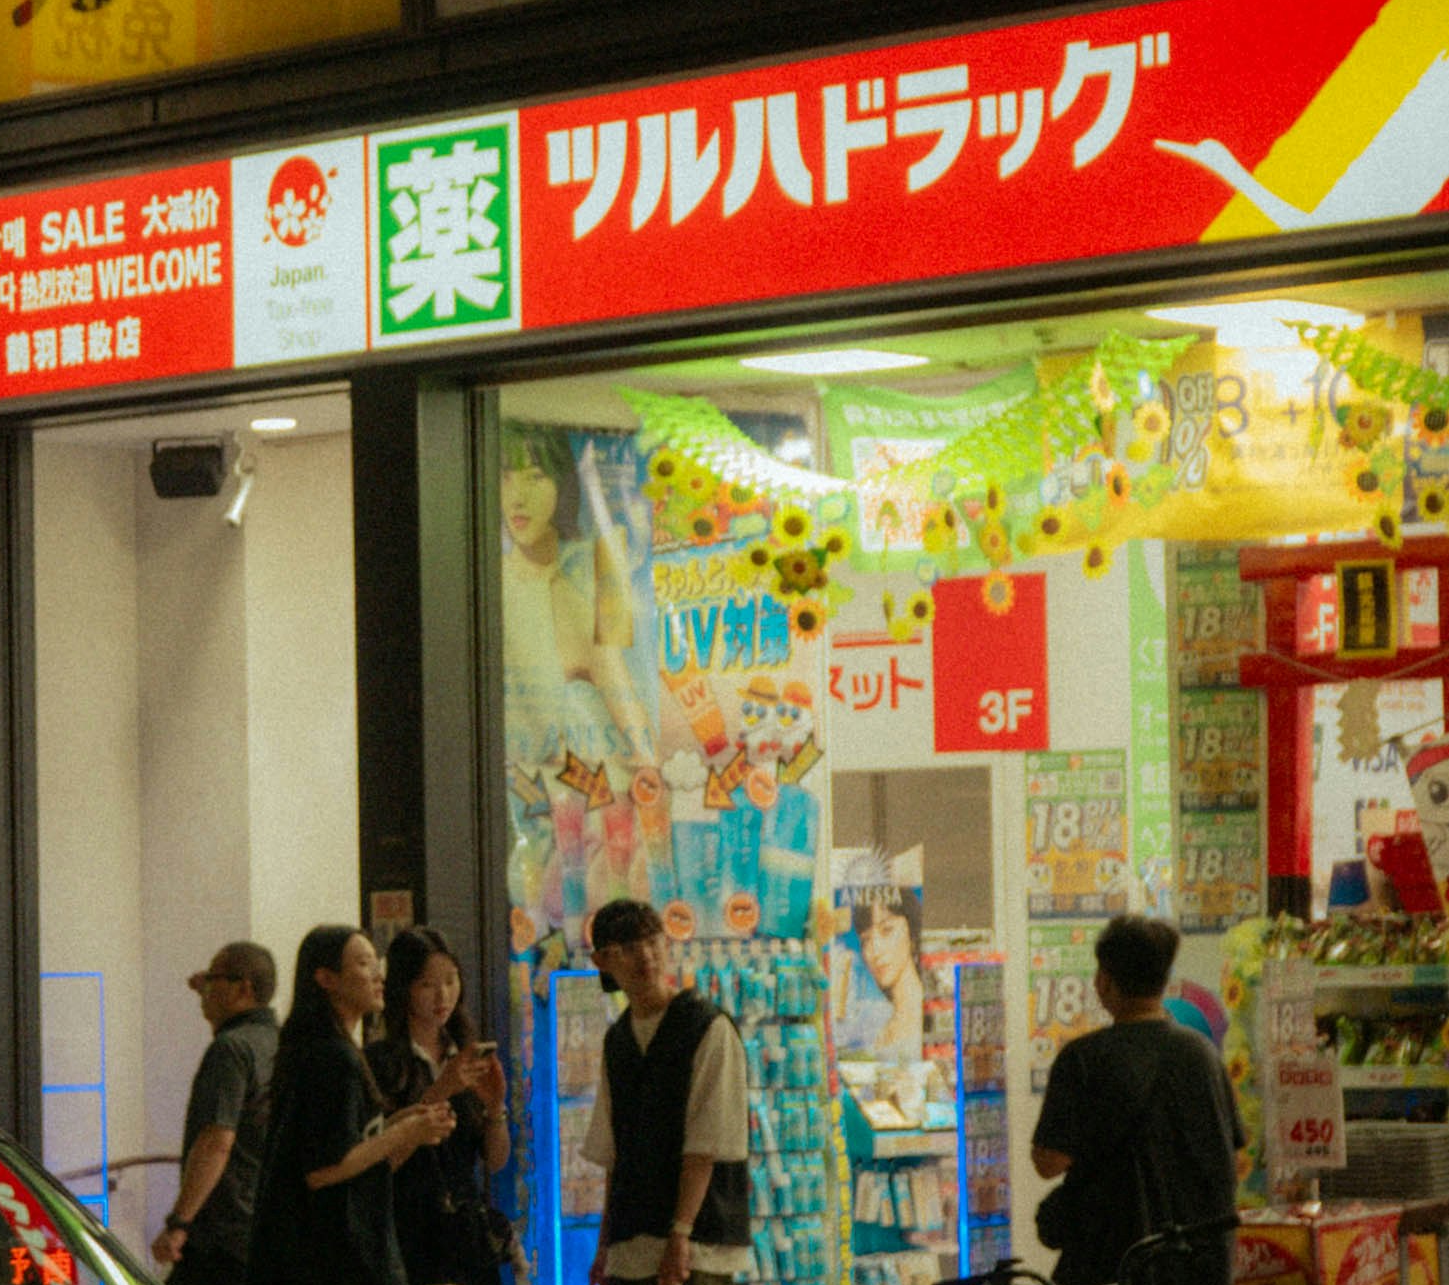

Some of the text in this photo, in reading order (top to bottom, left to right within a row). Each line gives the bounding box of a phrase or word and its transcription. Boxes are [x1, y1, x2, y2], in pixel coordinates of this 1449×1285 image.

[546, 32, 1170, 242] ツルハドラッグ
[39, 200, 126, 255] SALE
[385, 139, 502, 322] 薬
[97, 241, 223, 301] WELCOME
[977, 687, 1034, 734] 3F
[1032, 801, 1081, 852] 18
[840, 884, 903, 905] ANESSA
